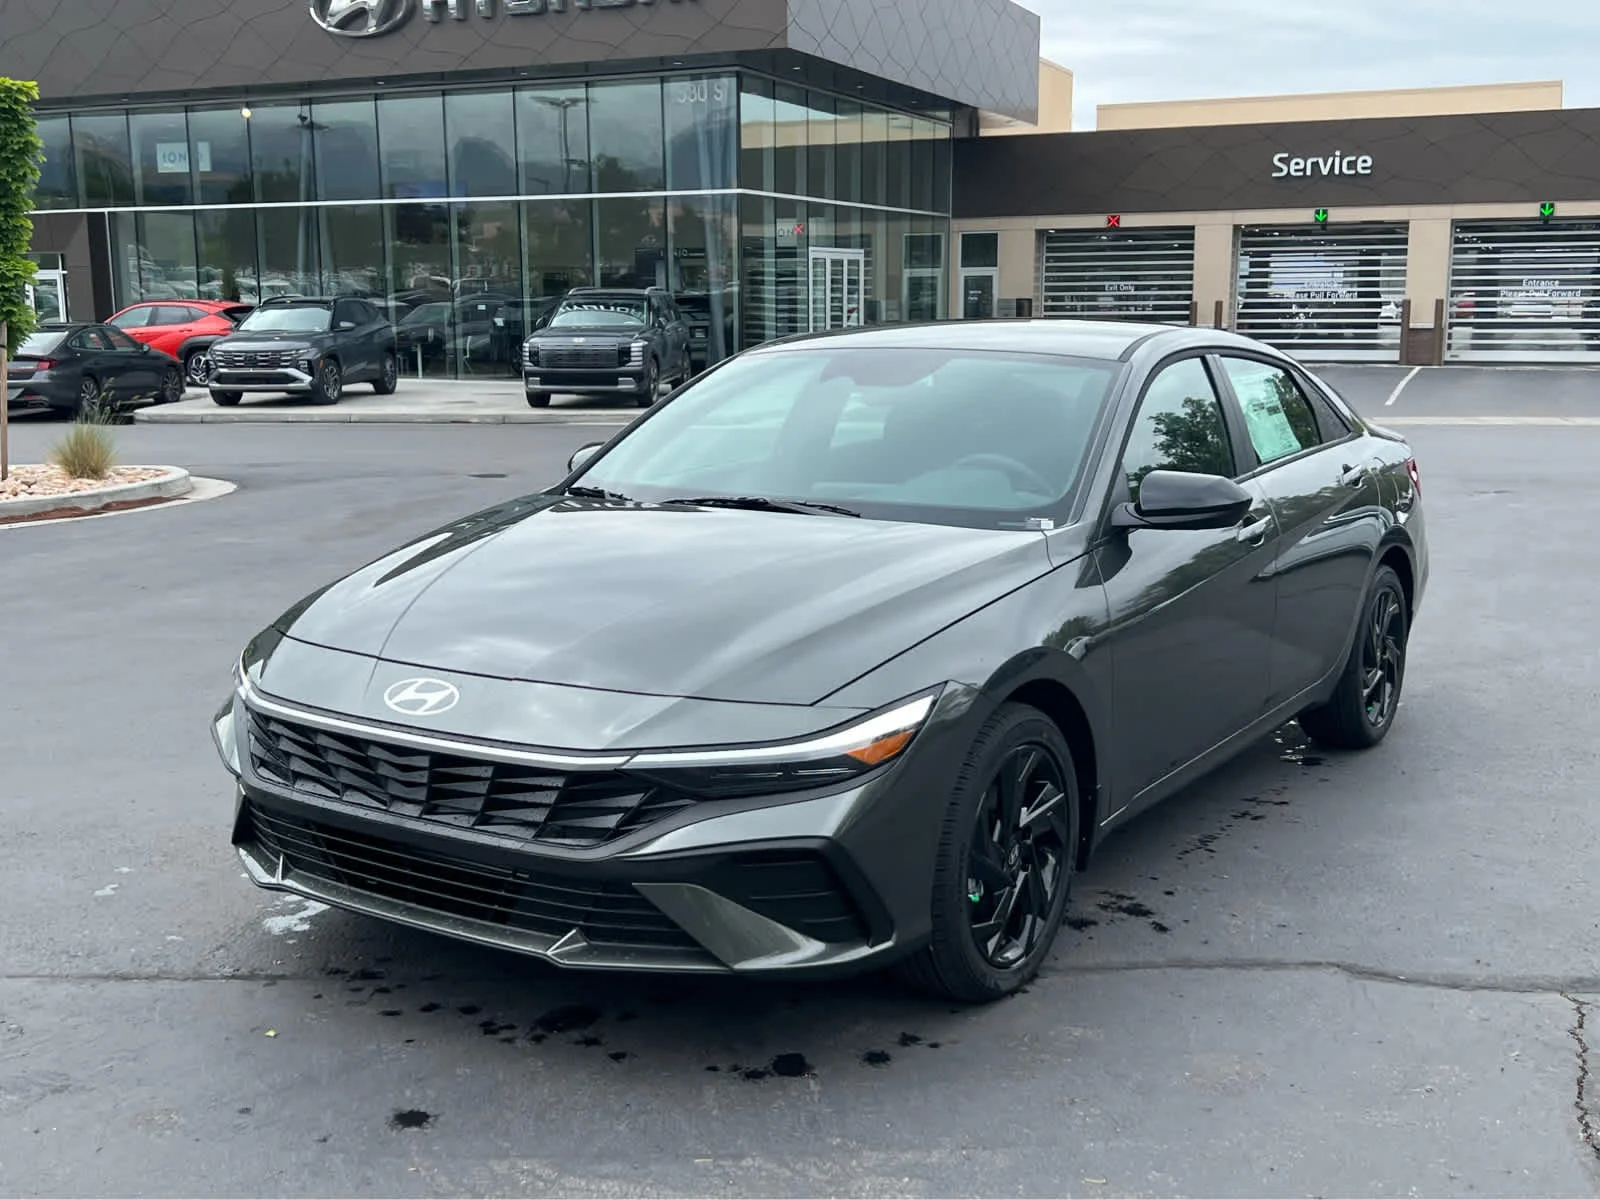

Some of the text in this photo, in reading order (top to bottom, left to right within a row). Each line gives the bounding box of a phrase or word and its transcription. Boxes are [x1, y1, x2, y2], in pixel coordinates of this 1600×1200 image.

[1271, 150, 1373, 177] Service
[1119, 283, 1135, 293] Only
[1522, 279, 1560, 288] Entrance
[1310, 290, 1325, 299] Pull
[1326, 290, 1358, 299] Forward
[1528, 288, 1546, 297] Pull
[1548, 288, 1581, 297] Forward
